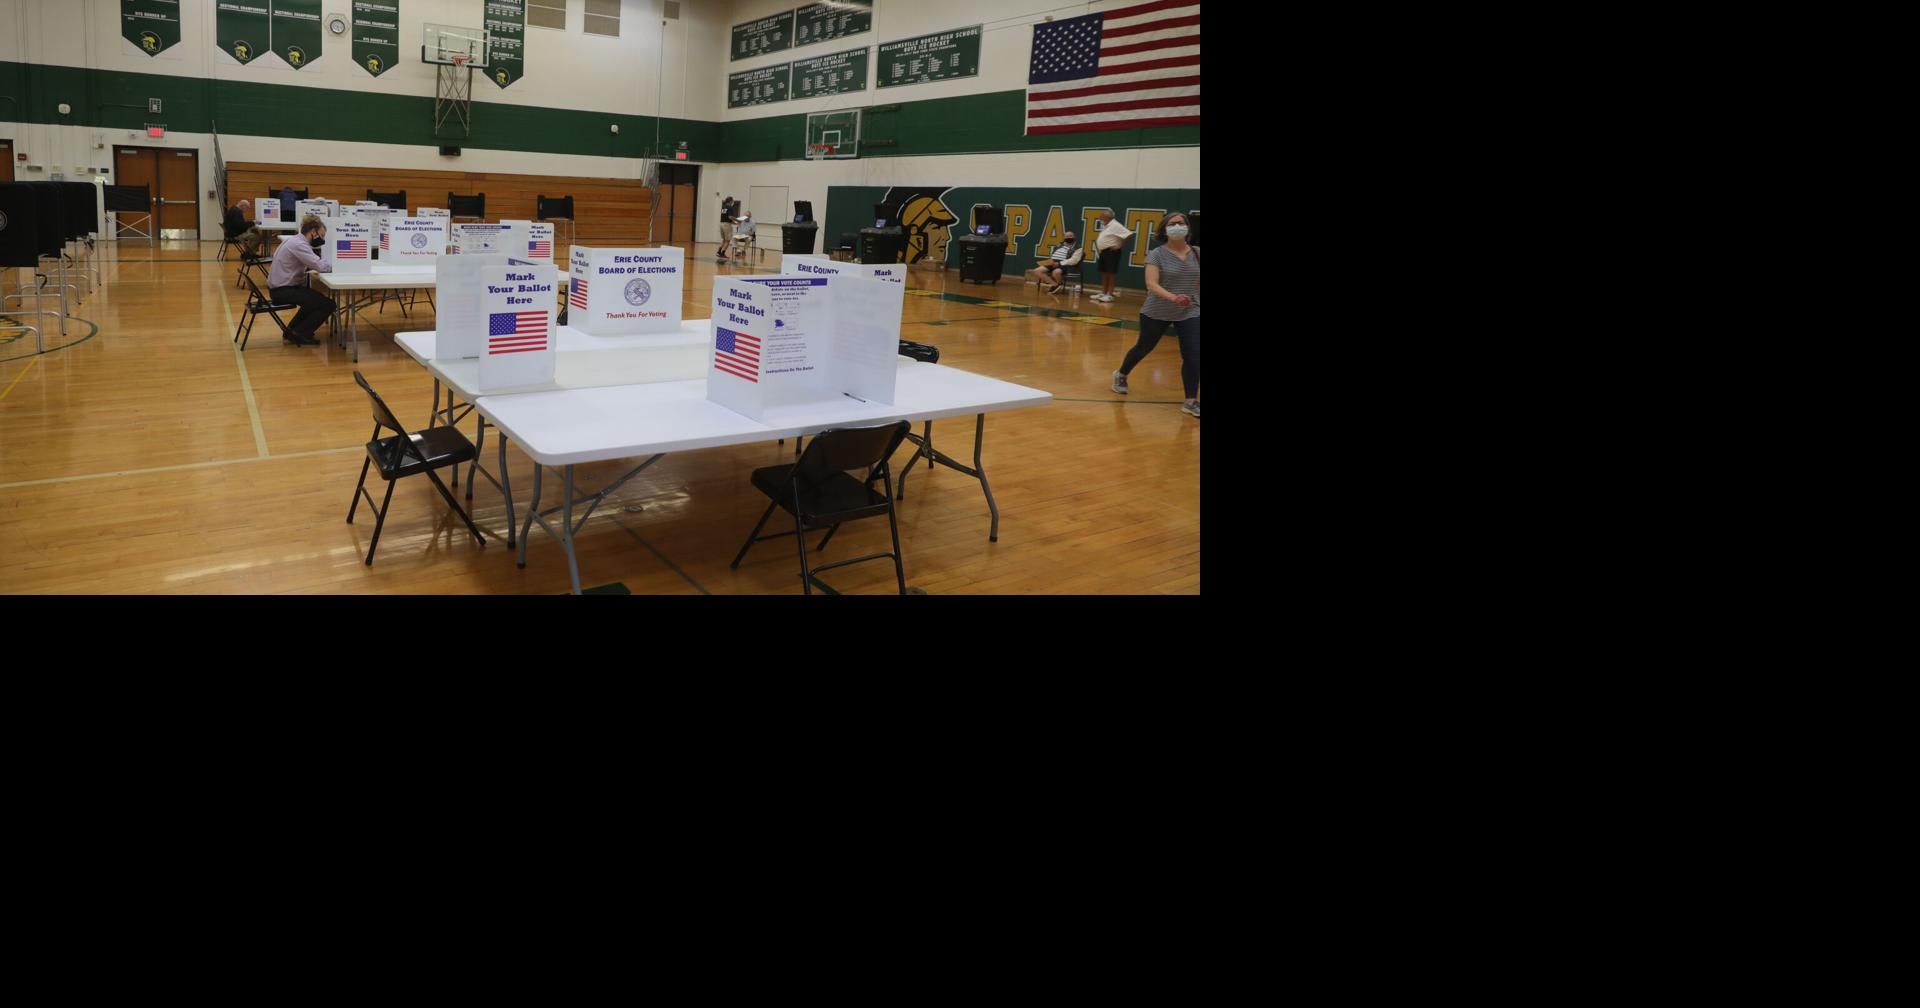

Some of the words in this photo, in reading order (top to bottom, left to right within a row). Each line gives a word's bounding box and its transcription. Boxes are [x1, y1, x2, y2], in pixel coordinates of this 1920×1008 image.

[881, 40, 918, 52] WILLIAMSVILLE
[920, 36, 938, 45] NORTH
[940, 33, 954, 42] HIGH
[955, 28, 978, 38] SCHOOL
[929, 40, 950, 48] HOCKEY
[794, 56, 822, 68] WILLIAMSVILLE
[824, 54, 838, 63] NORTH
[838, 52, 848, 60] HIGH
[849, 49, 866, 58] SCHOOL
[775, 64, 789, 72] SCHOOL
[798, 264, 812, 272] ERIE
[813, 266, 839, 274] COUNTY
[506, 273, 535, 281] Mark
[488, 285, 514, 294] Your
[518, 284, 551, 292] Ballot
[730, 288, 752, 300] Mark
[507, 296, 532, 304] Here
[717, 298, 735, 309] Your
[738, 303, 764, 317] Ballot
[729, 313, 749, 326] Here
